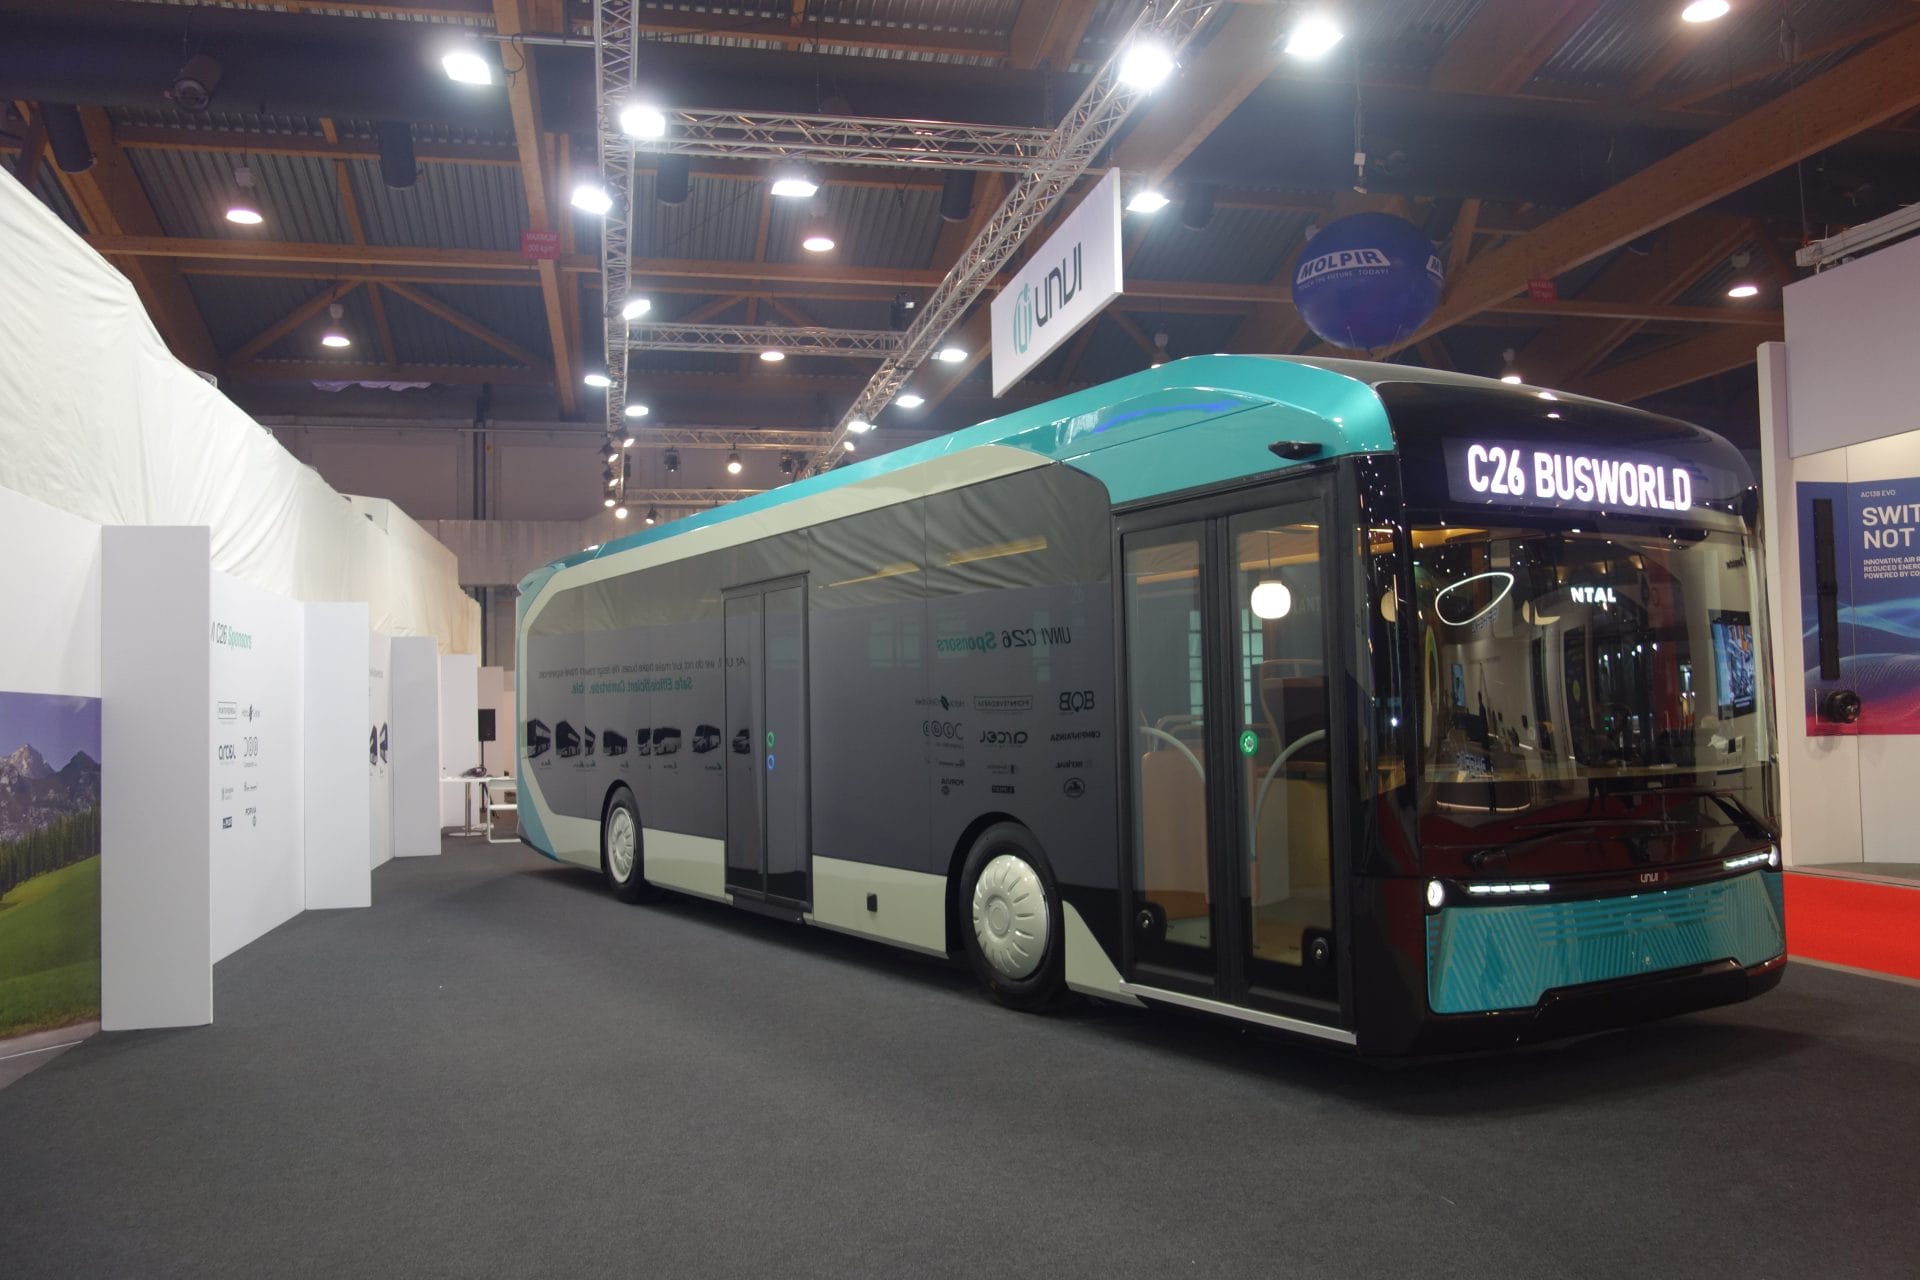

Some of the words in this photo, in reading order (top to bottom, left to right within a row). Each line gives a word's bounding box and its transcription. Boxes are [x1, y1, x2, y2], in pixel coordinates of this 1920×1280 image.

[1300, 250, 1382, 280] MOLPIR
[1467, 444, 1525, 494] C26
[1533, 452, 1691, 511] BUSWORLD
[1882, 489, 1896, 498] EVO
[1863, 527, 1915, 550] NOT
[1863, 557, 1902, 566] INNOVATIVE
[1903, 556, 1915, 564] AIR
[1863, 564, 1897, 573] REDUCED
[1863, 570, 1898, 579] POWERED
[1899, 570, 1909, 578] BY
